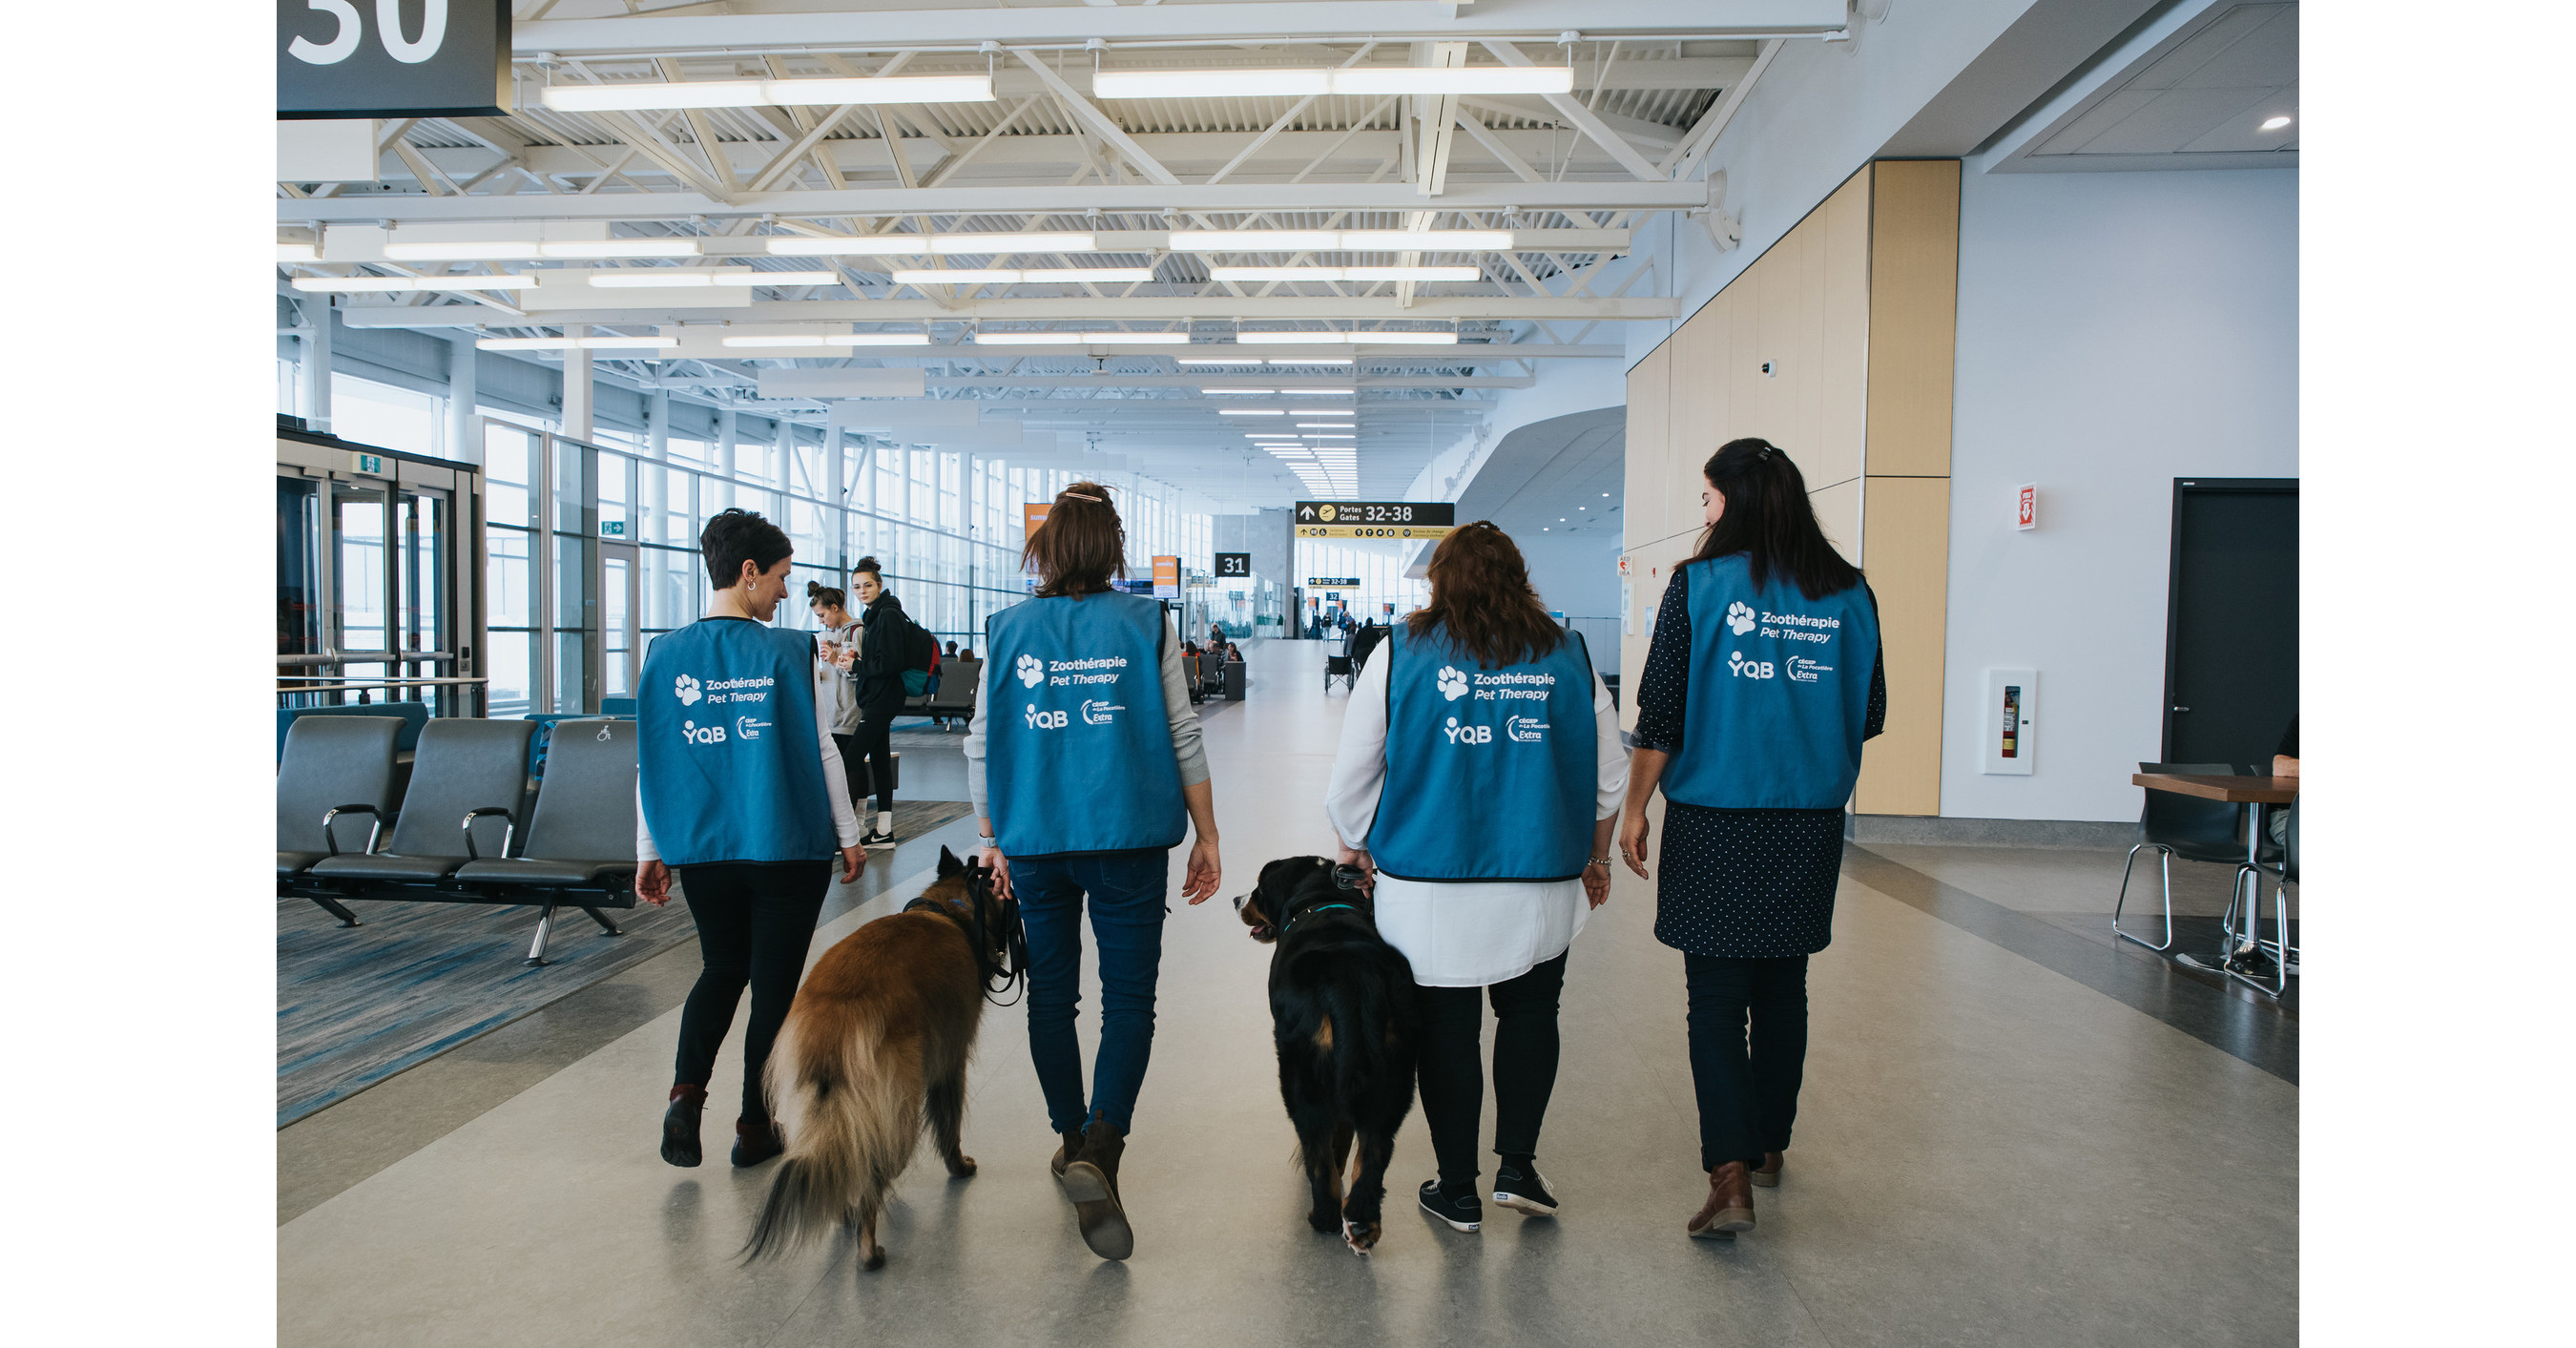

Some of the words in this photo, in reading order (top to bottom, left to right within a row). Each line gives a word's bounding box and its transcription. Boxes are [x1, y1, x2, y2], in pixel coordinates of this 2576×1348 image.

[287, 0, 448, 66] 30
[1365, 506, 1413, 522] 32-38
[1224, 557, 1245, 573] 31
[1761, 612, 1840, 630] Zoothérapie
[1759, 627, 1780, 638] Pet
[1783, 629, 1831, 644] Therapy
[1049, 655, 1128, 672] Zoothérapie
[1727, 659, 1775, 680] YQB
[1049, 675, 1070, 686] Pet
[1072, 674, 1120, 684] Therapy
[1474, 672, 1556, 687] Zoothérapie
[1797, 671, 1818, 680] Extra
[707, 694, 727, 704] Pet
[1474, 689, 1496, 700] Pet
[1499, 688, 1549, 701] Therapy
[1025, 710, 1069, 730] YQB
[1093, 714, 1112, 722] Extra
[682, 725, 727, 744] YQB
[1444, 725, 1492, 745] YQB
[1519, 730, 1542, 739] Extra
